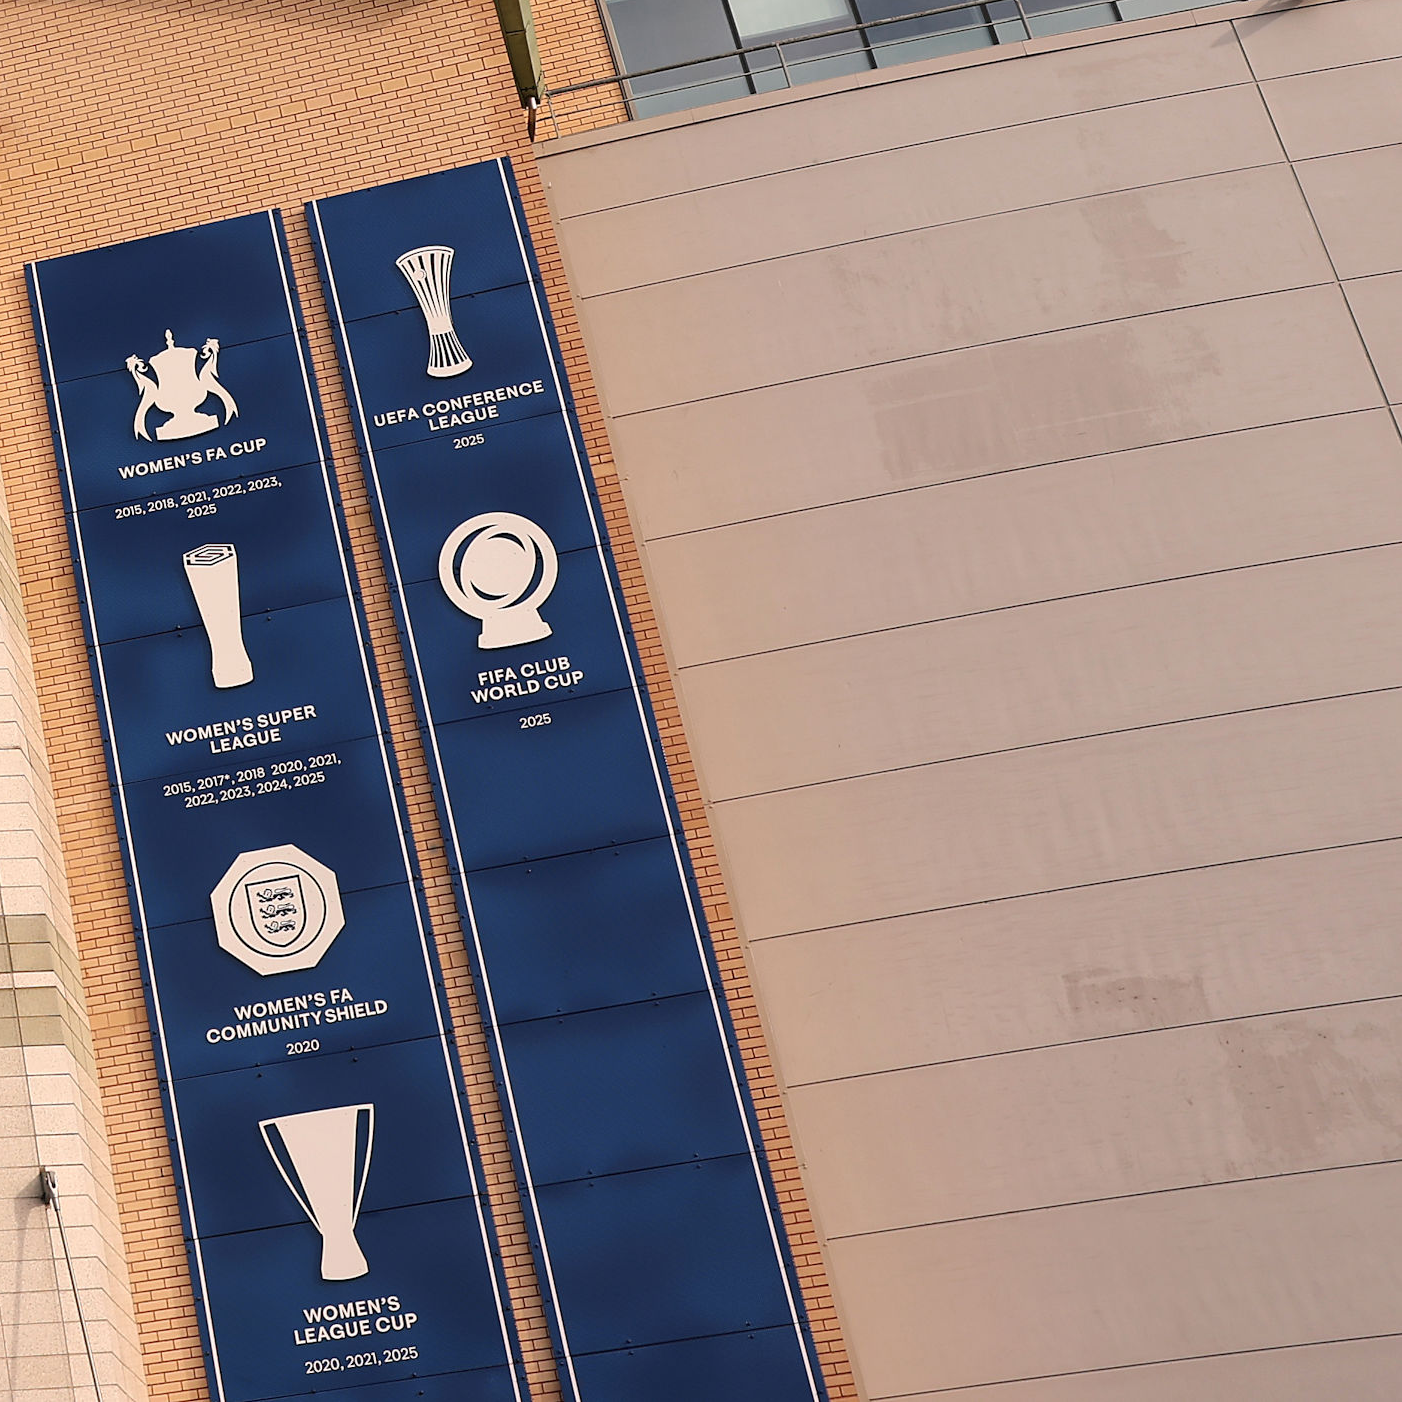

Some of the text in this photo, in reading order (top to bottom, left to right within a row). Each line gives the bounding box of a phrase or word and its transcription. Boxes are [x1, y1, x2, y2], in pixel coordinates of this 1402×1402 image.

[373, 380, 545, 428] UEFA CONFERENCE
[428, 405, 500, 432] LEAGUE
[452, 433, 485, 449] 2025
[118, 438, 267, 480] WOMEN’S FA CUP
[114, 476, 282, 520] 2015, 2018, 2021, 2022, 2023,
[186, 503, 217, 519] 2025
[470, 670, 584, 704] WORLD CUP
[477, 656, 571, 686] FIFA CLUB
[165, 704, 317, 746] WOMEN’S SUPER
[519, 712, 551, 729] 2025
[209, 728, 282, 754] LEAGUE
[162, 781, 195, 797] 2015,
[236, 766, 266, 782] 2018
[270, 759, 307, 776] 2020,
[308, 753, 342, 769] 2021,
[184, 771, 325, 808] 2022, 2023, 2024, 2025
[233, 988, 354, 1021] WOMEN’S FA
[206, 999, 388, 1044] COMMUNITY SHIELD
[285, 1038, 320, 1056] 2020
[302, 1295, 401, 1324] WOMEN’S
[293, 1312, 418, 1346] LEAGUE CUP
[304, 1346, 419, 1375] 2020, 2021, 2025
